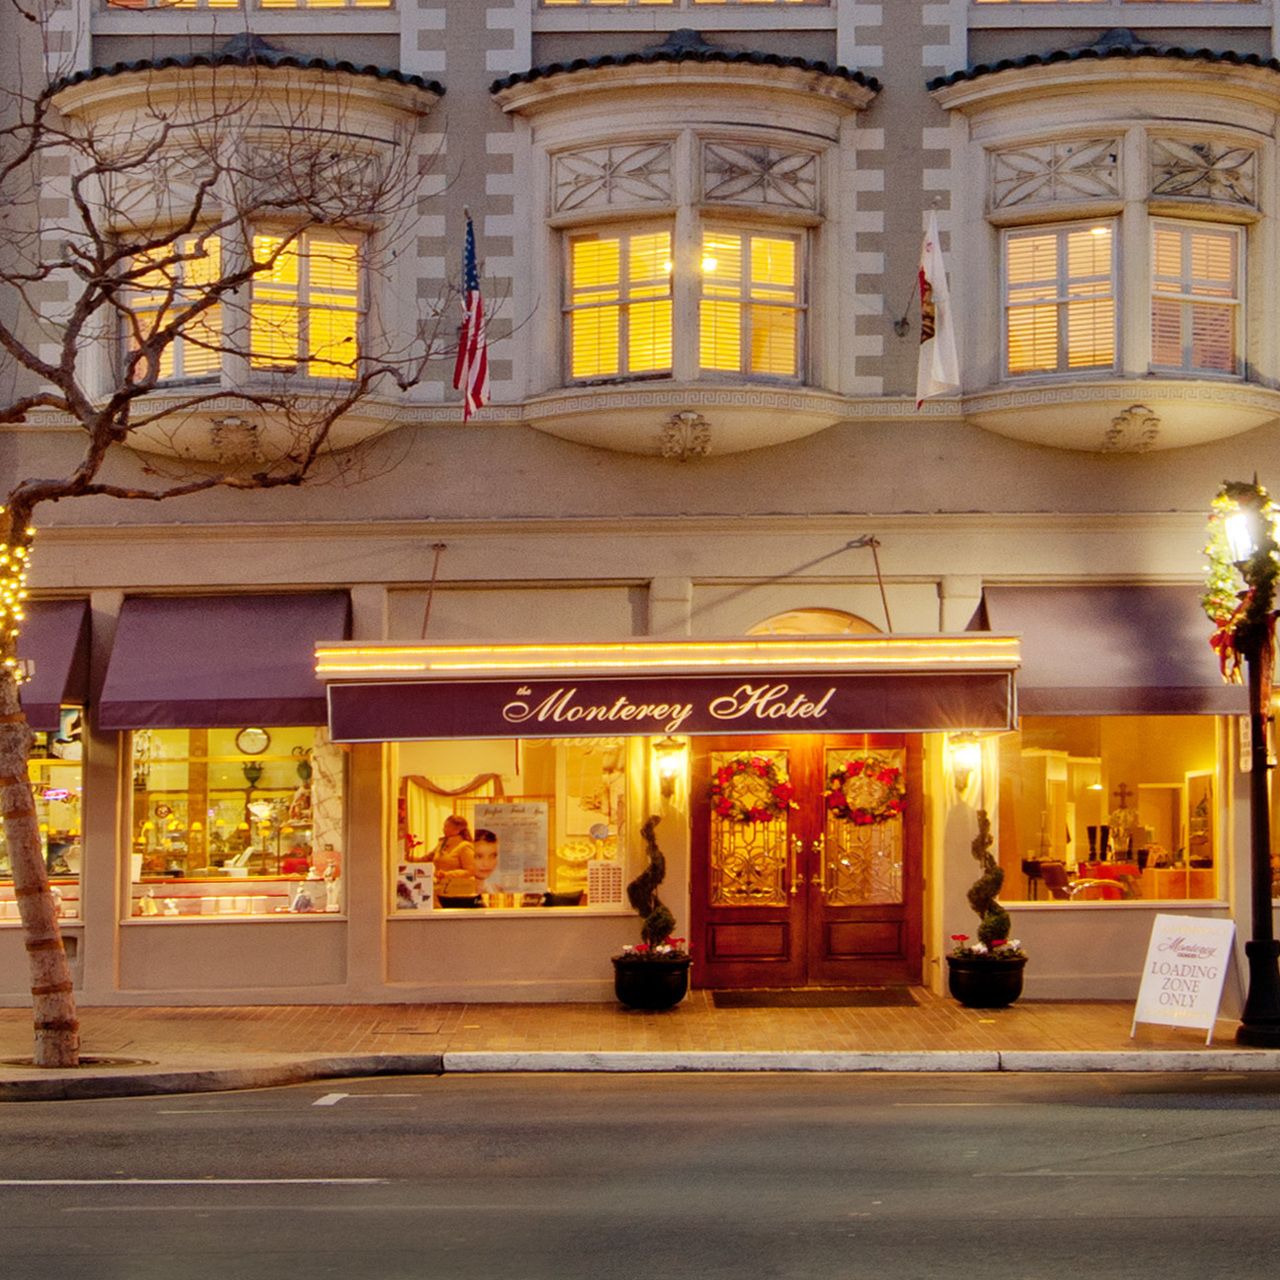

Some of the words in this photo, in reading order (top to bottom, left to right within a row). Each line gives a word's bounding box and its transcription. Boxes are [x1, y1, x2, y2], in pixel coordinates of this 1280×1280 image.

[503, 688, 693, 732] Monterey
[709, 684, 836, 720] Hotel
[1151, 961, 1218, 980] LOADING
[1162, 977, 1200, 993] ZONE
[1159, 991, 1198, 1008] ONLY
